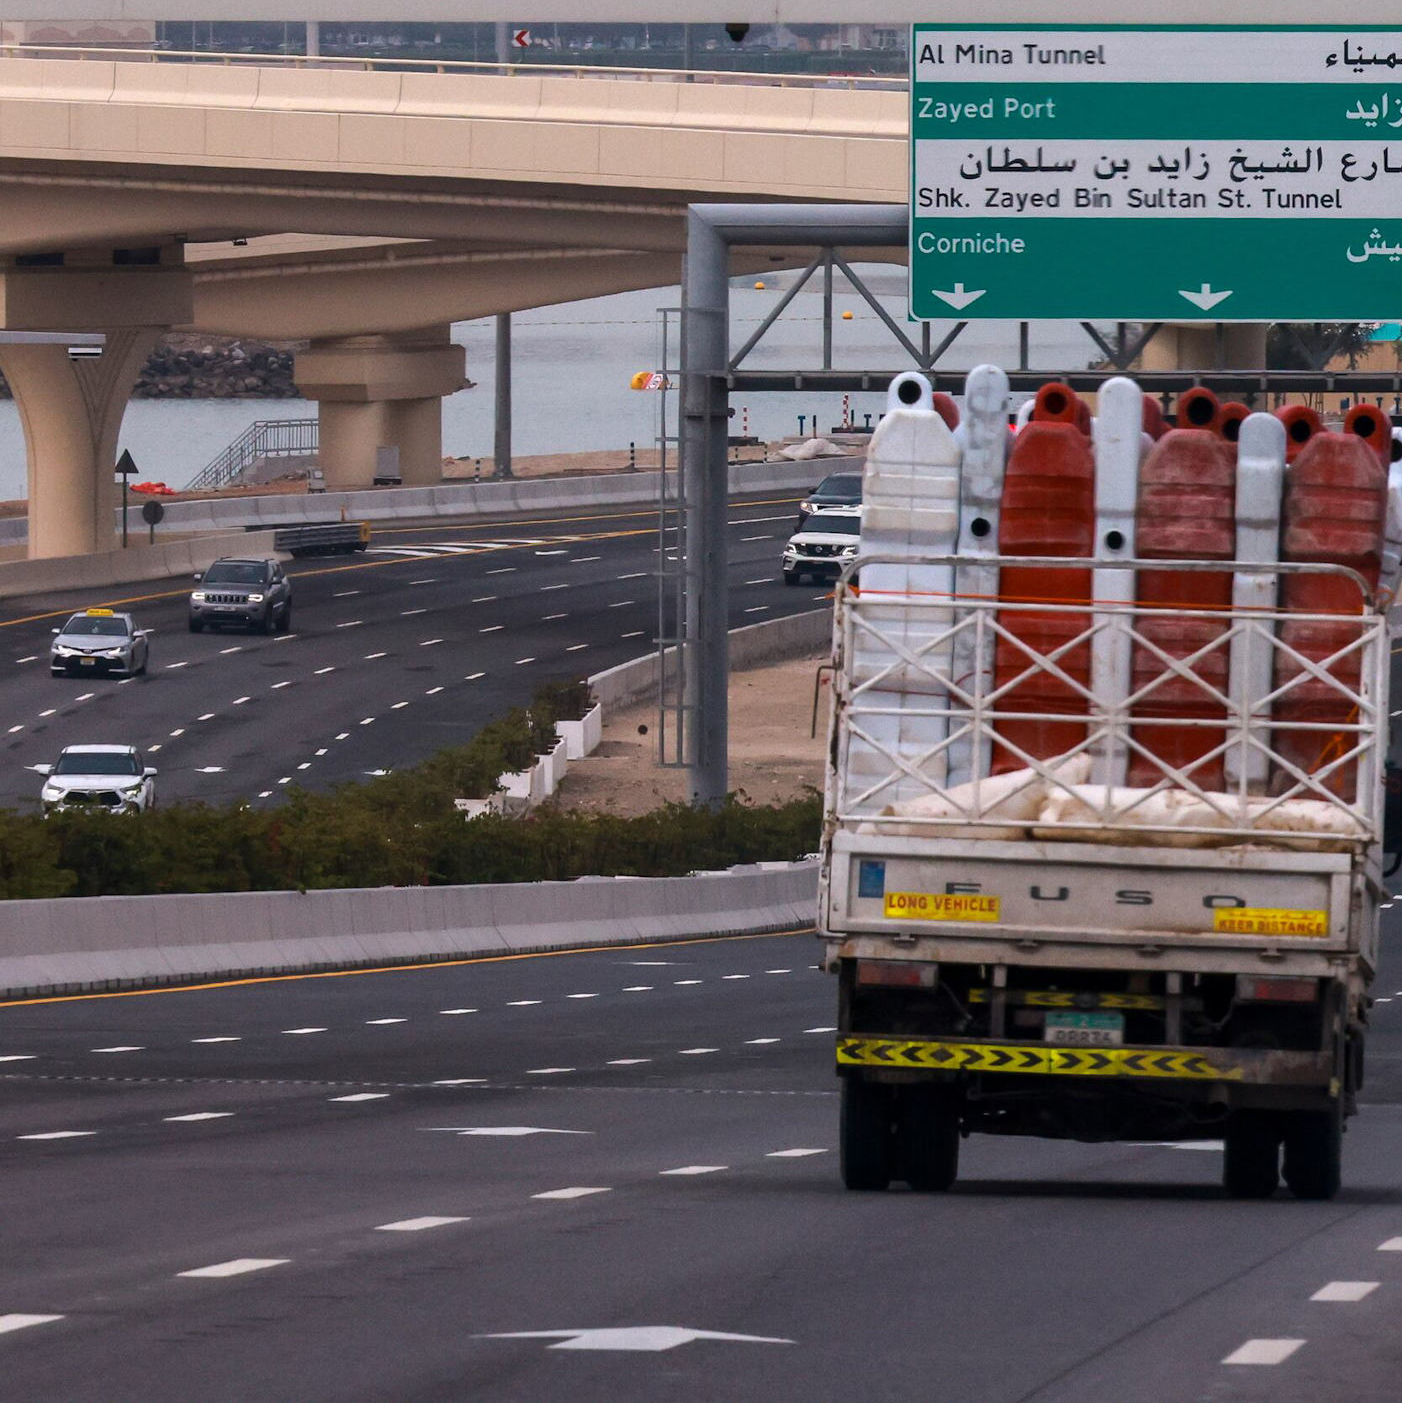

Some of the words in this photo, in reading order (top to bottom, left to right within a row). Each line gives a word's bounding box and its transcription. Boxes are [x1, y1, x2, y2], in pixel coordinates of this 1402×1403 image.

[919, 44, 944, 64] Al
[955, 44, 1013, 64] Mina
[1024, 44, 1106, 65] Tunnel
[918, 98, 994, 123] Zayed
[1004, 98, 1056, 119] Port
[960, 146, 1077, 180] سلطان
[1094, 154, 1129, 180] بن
[1148, 146, 1210, 180] زايد
[1229, 146, 1323, 182] الشيخ
[918, 187, 971, 208] Shk.
[984, 187, 1060, 212] Zayed
[1074, 187, 1112, 208] Bin
[1127, 188, 1206, 209] Sultan
[1218, 188, 1251, 209] St.
[1262, 188, 1343, 209] Tunnel
[918, 232, 1026, 254] Corniche
[888, 896, 928, 910] LONG
[934, 898, 996, 913] VEHICLE
[1258, 921, 1324, 936] DISTANCE
